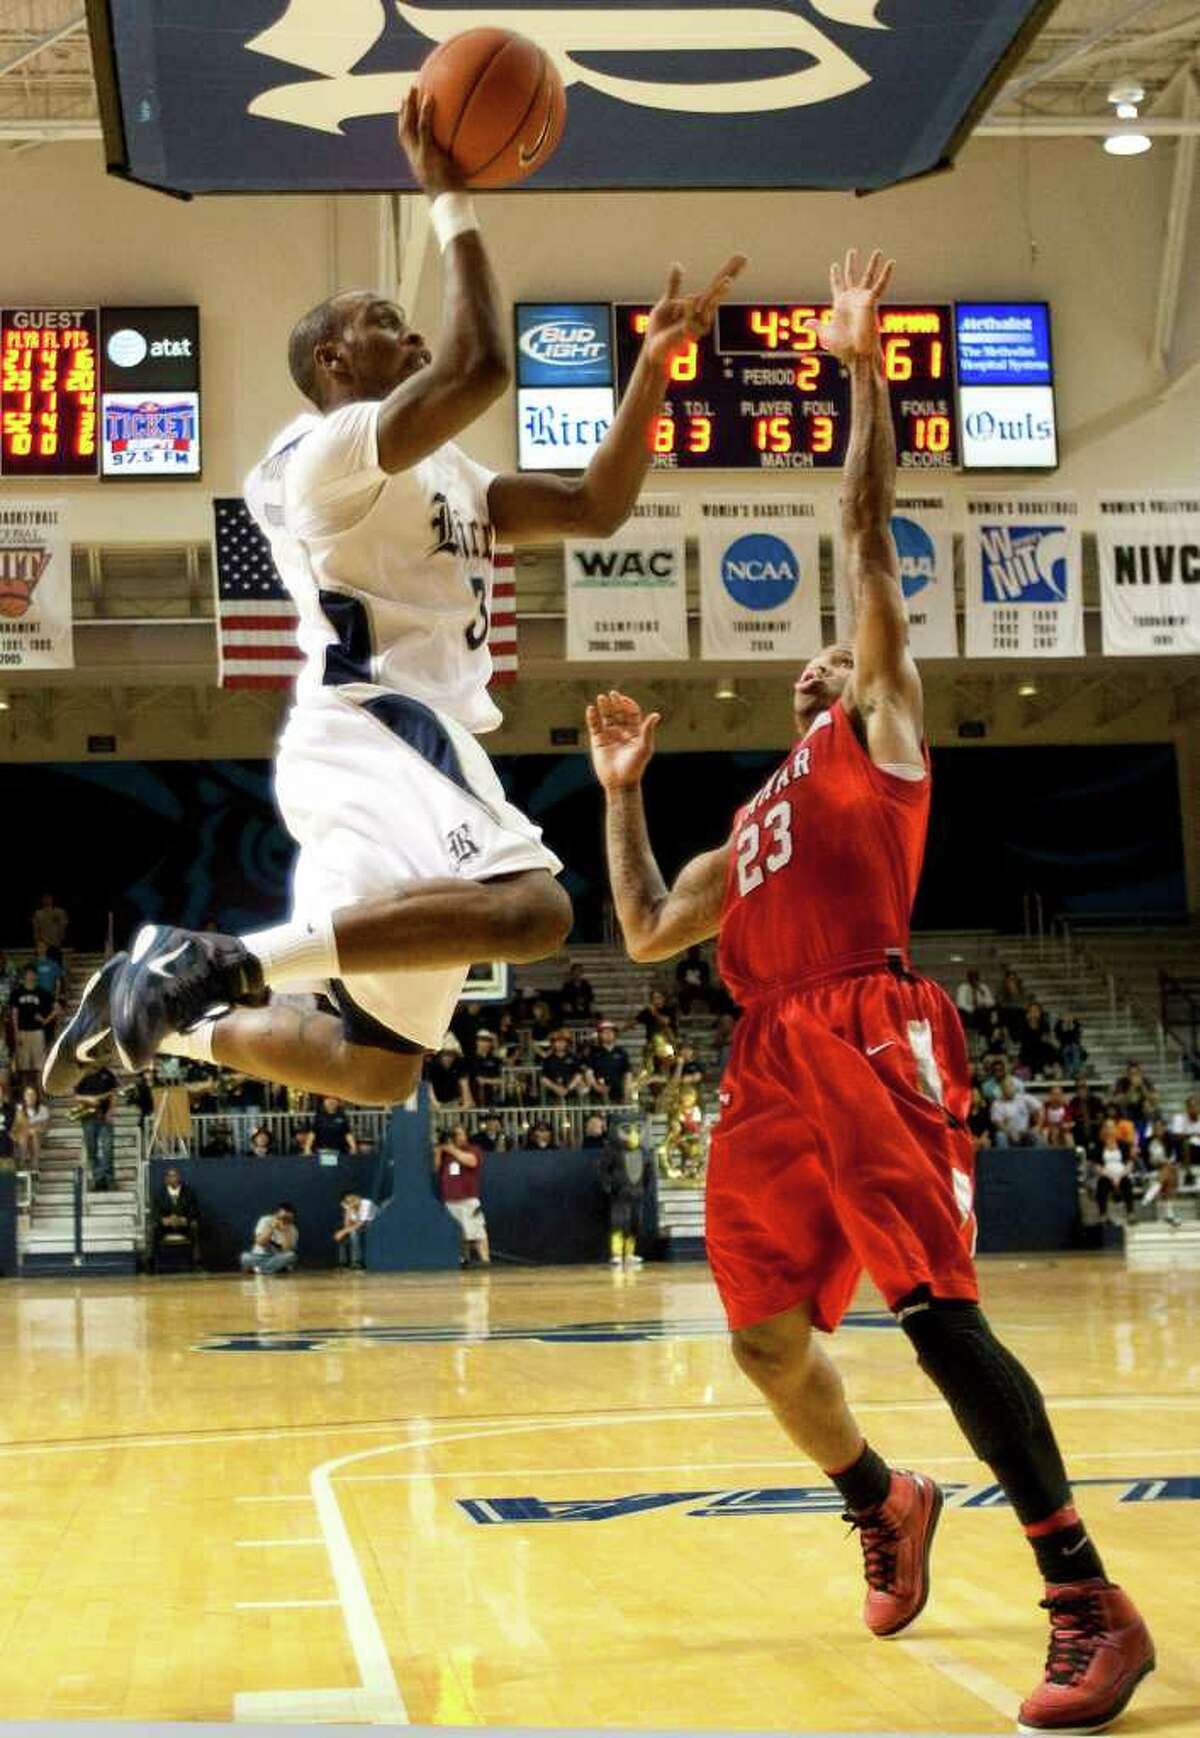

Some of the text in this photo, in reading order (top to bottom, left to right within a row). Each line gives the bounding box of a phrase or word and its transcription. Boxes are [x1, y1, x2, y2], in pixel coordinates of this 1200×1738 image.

[13, 311, 84, 328] GUEST
[150, 338, 192, 357] at&t
[533, 342, 605, 358] LIGHT
[743, 369, 795, 386] PERIOD
[797, 356, 820, 391] 2
[741, 401, 839, 416] PLAYER FOUL
[901, 402, 947, 416] FOULS
[106, 411, 194, 441] TICKET
[689, 418, 711, 453] 3
[757, 418, 792, 453] 15
[812, 417, 833, 452] 3
[916, 417, 950, 452] 10
[965, 410, 1050, 442] Owls
[164, 452, 189, 463] FM
[761, 453, 814, 468] MATCH
[901, 453, 951, 467] SCORE
[702, 504, 815, 517] WOMEN'S BASKETBALL
[1019, 502, 1078, 515] BASKETBALL
[574, 551, 673, 577] WAC
[726, 561, 796, 580] NCAA
[1114, 545, 1200, 585] NIVC
[465, 577, 488, 650] 3
[737, 800, 793, 896] 23
